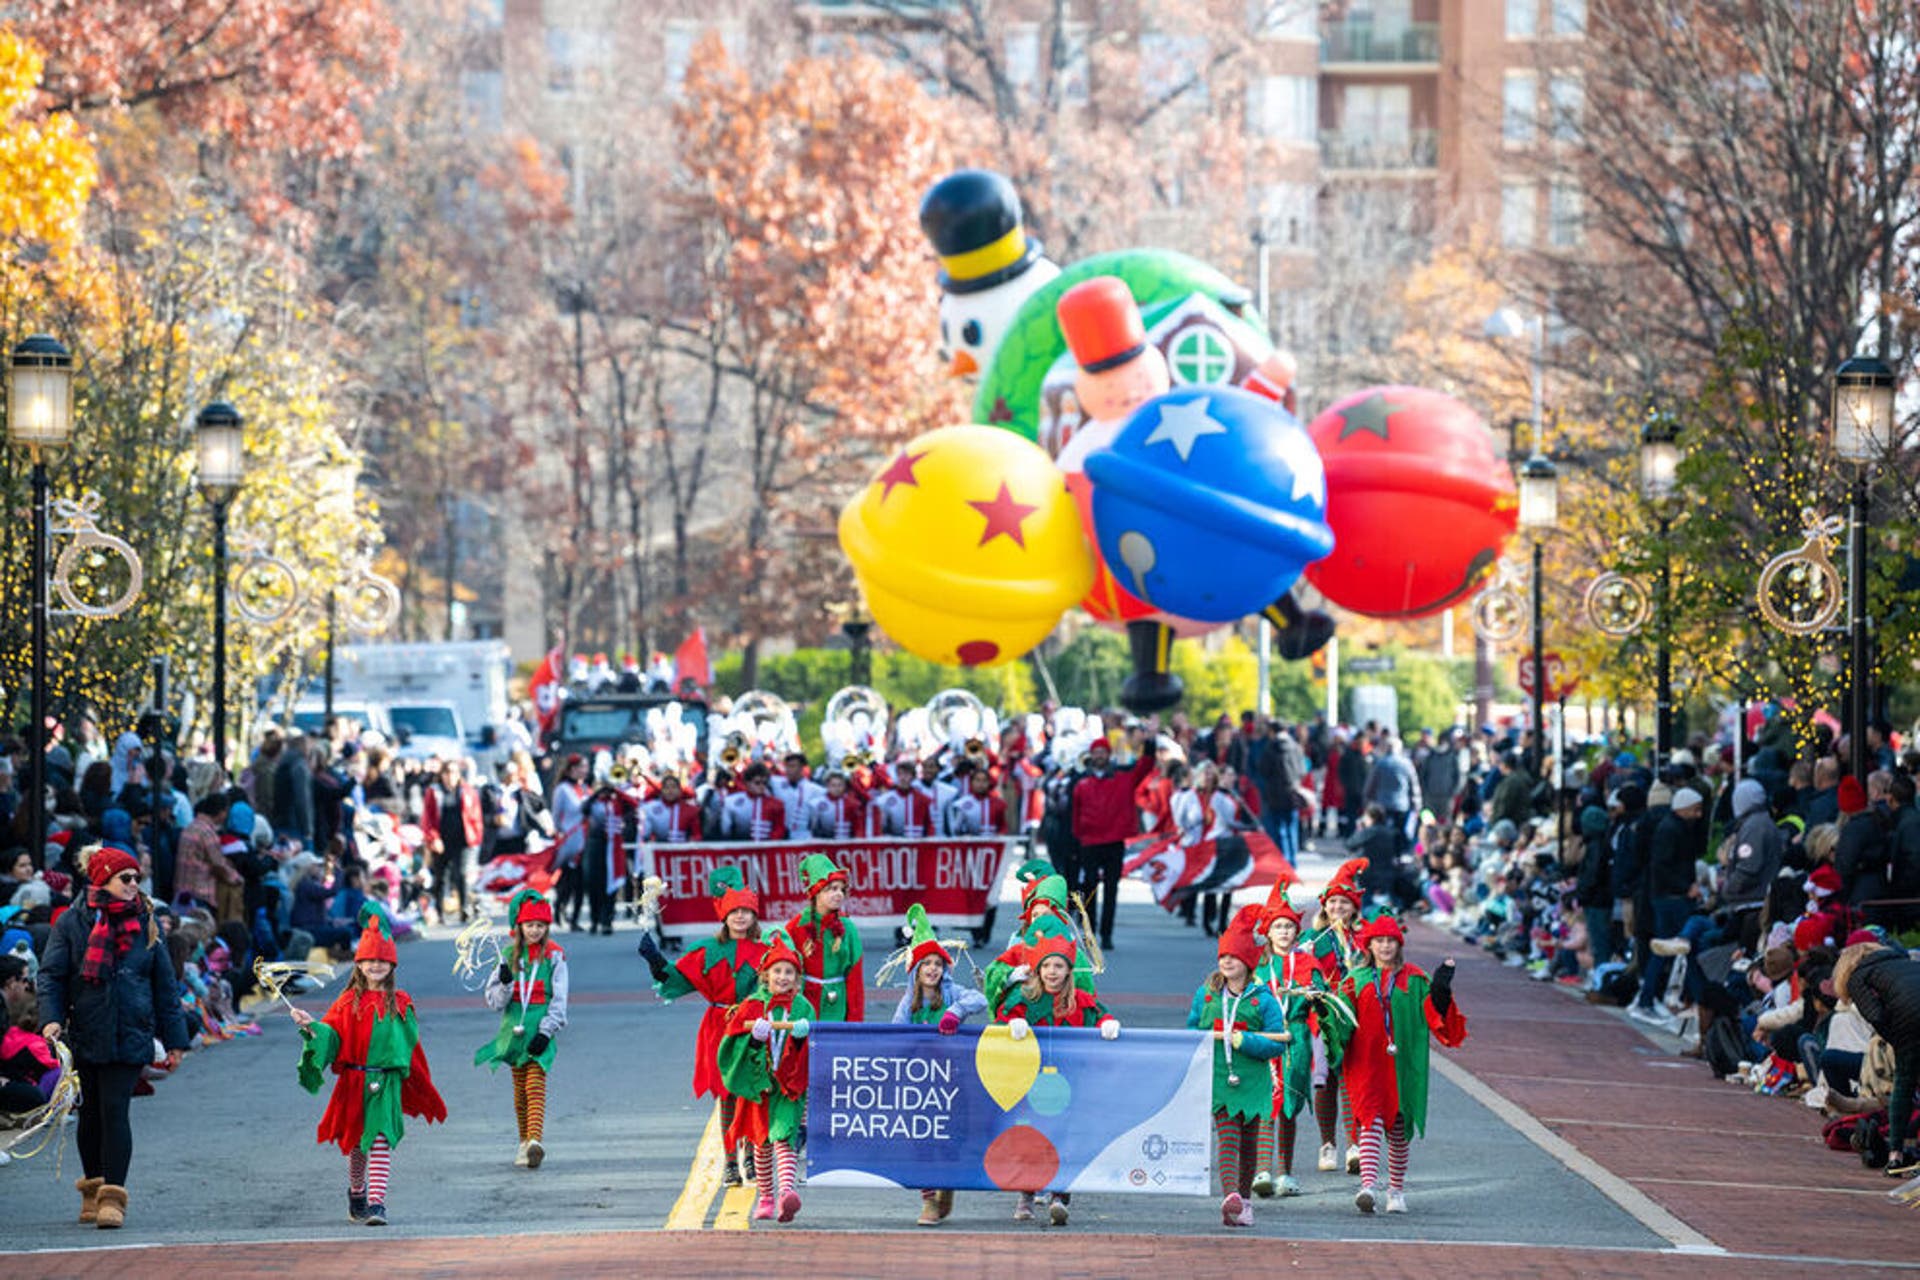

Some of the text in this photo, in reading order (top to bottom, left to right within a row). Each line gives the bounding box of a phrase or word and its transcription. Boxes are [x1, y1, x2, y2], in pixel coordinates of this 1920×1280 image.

[775, 851, 828, 896] HI
[935, 848, 996, 890] BAND
[832, 1056, 951, 1083] RESTON
[831, 1085, 959, 1111] HOLIDAY
[830, 1112, 951, 1139] PARADE
